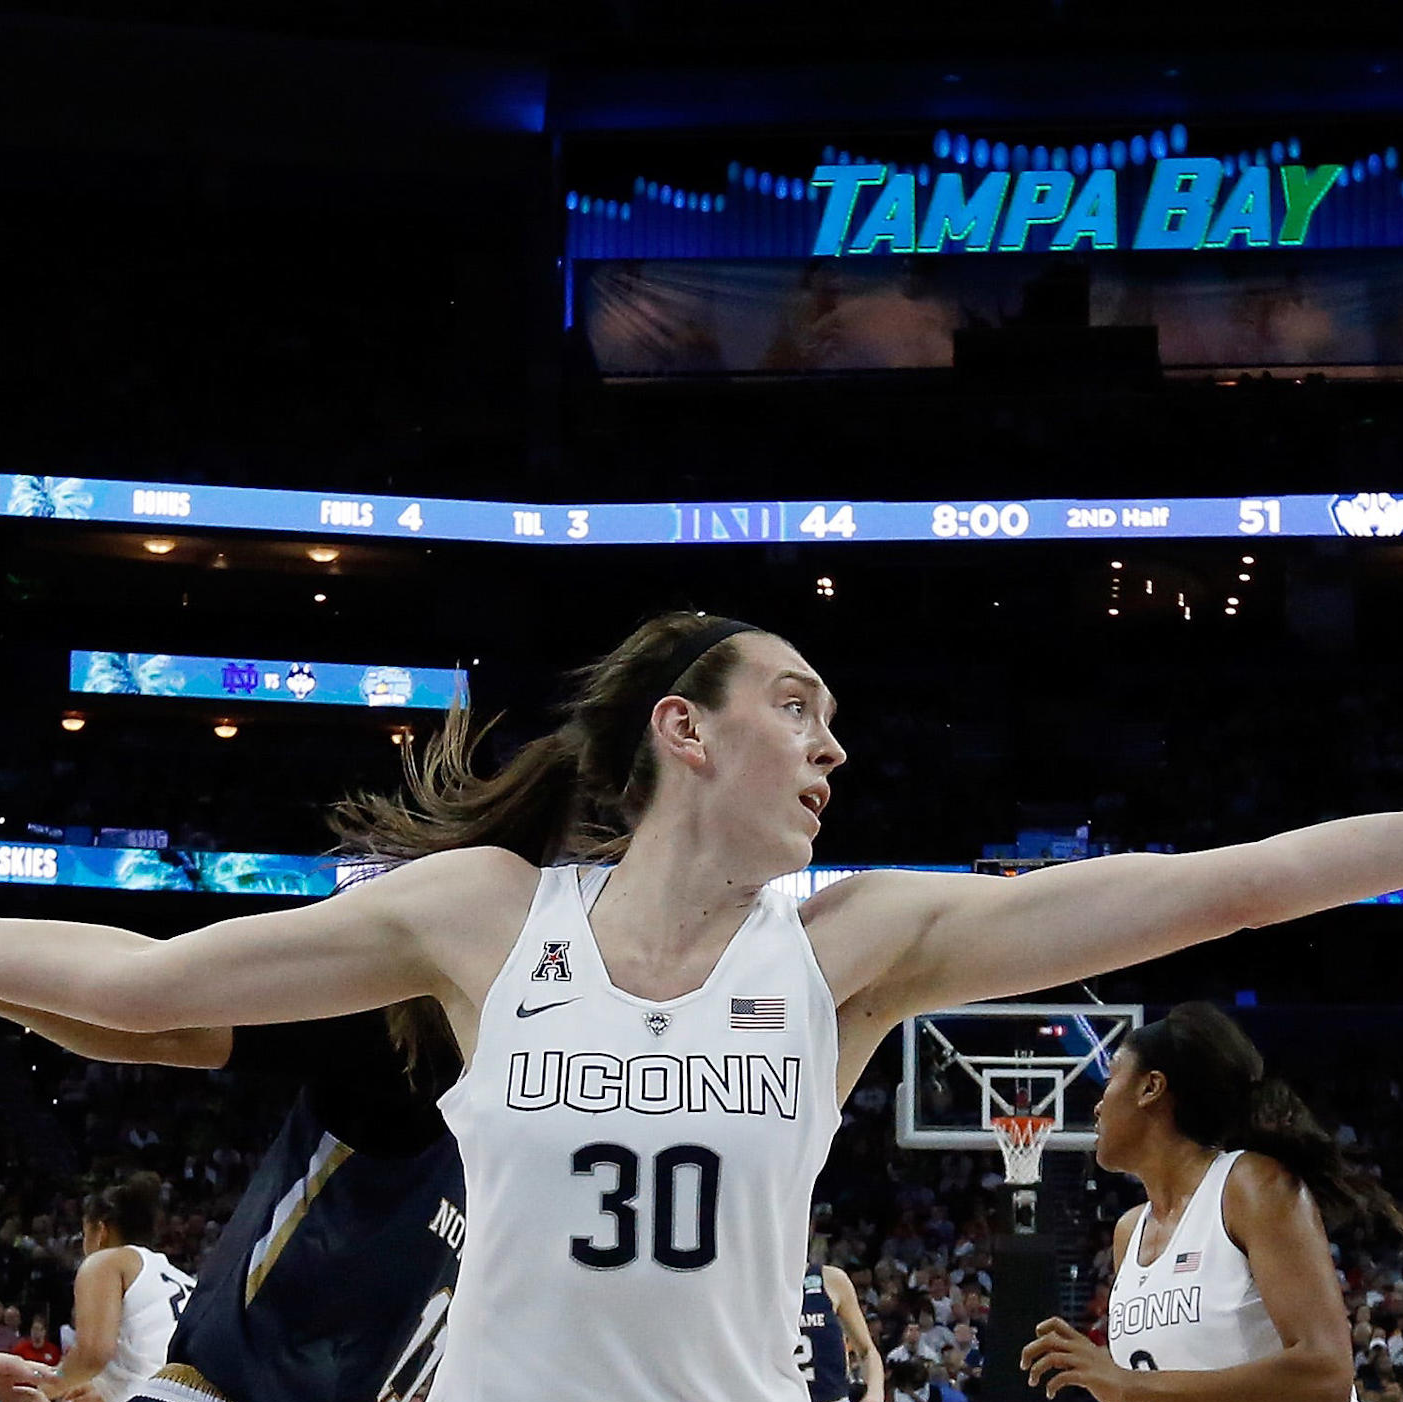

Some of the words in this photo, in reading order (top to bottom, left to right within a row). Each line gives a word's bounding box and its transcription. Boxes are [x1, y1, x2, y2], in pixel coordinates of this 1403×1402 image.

[810, 163, 1119, 256] TAMPA
[1132, 157, 1343, 249] BAY
[320, 500, 374, 527] FOULS
[397, 503, 423, 532] 4
[566, 510, 589, 539] 3
[799, 505, 857, 539] 44
[931, 504, 1029, 538] 8:00
[1067, 508, 1117, 528] 2ND
[1122, 507, 1170, 527] Half
[1238, 500, 1281, 534] 51
[506, 1051, 801, 1120] UCONN
[569, 1141, 721, 1272] 30
[798, 1313, 825, 1328] AME
[1109, 1286, 1201, 1340] CONN
